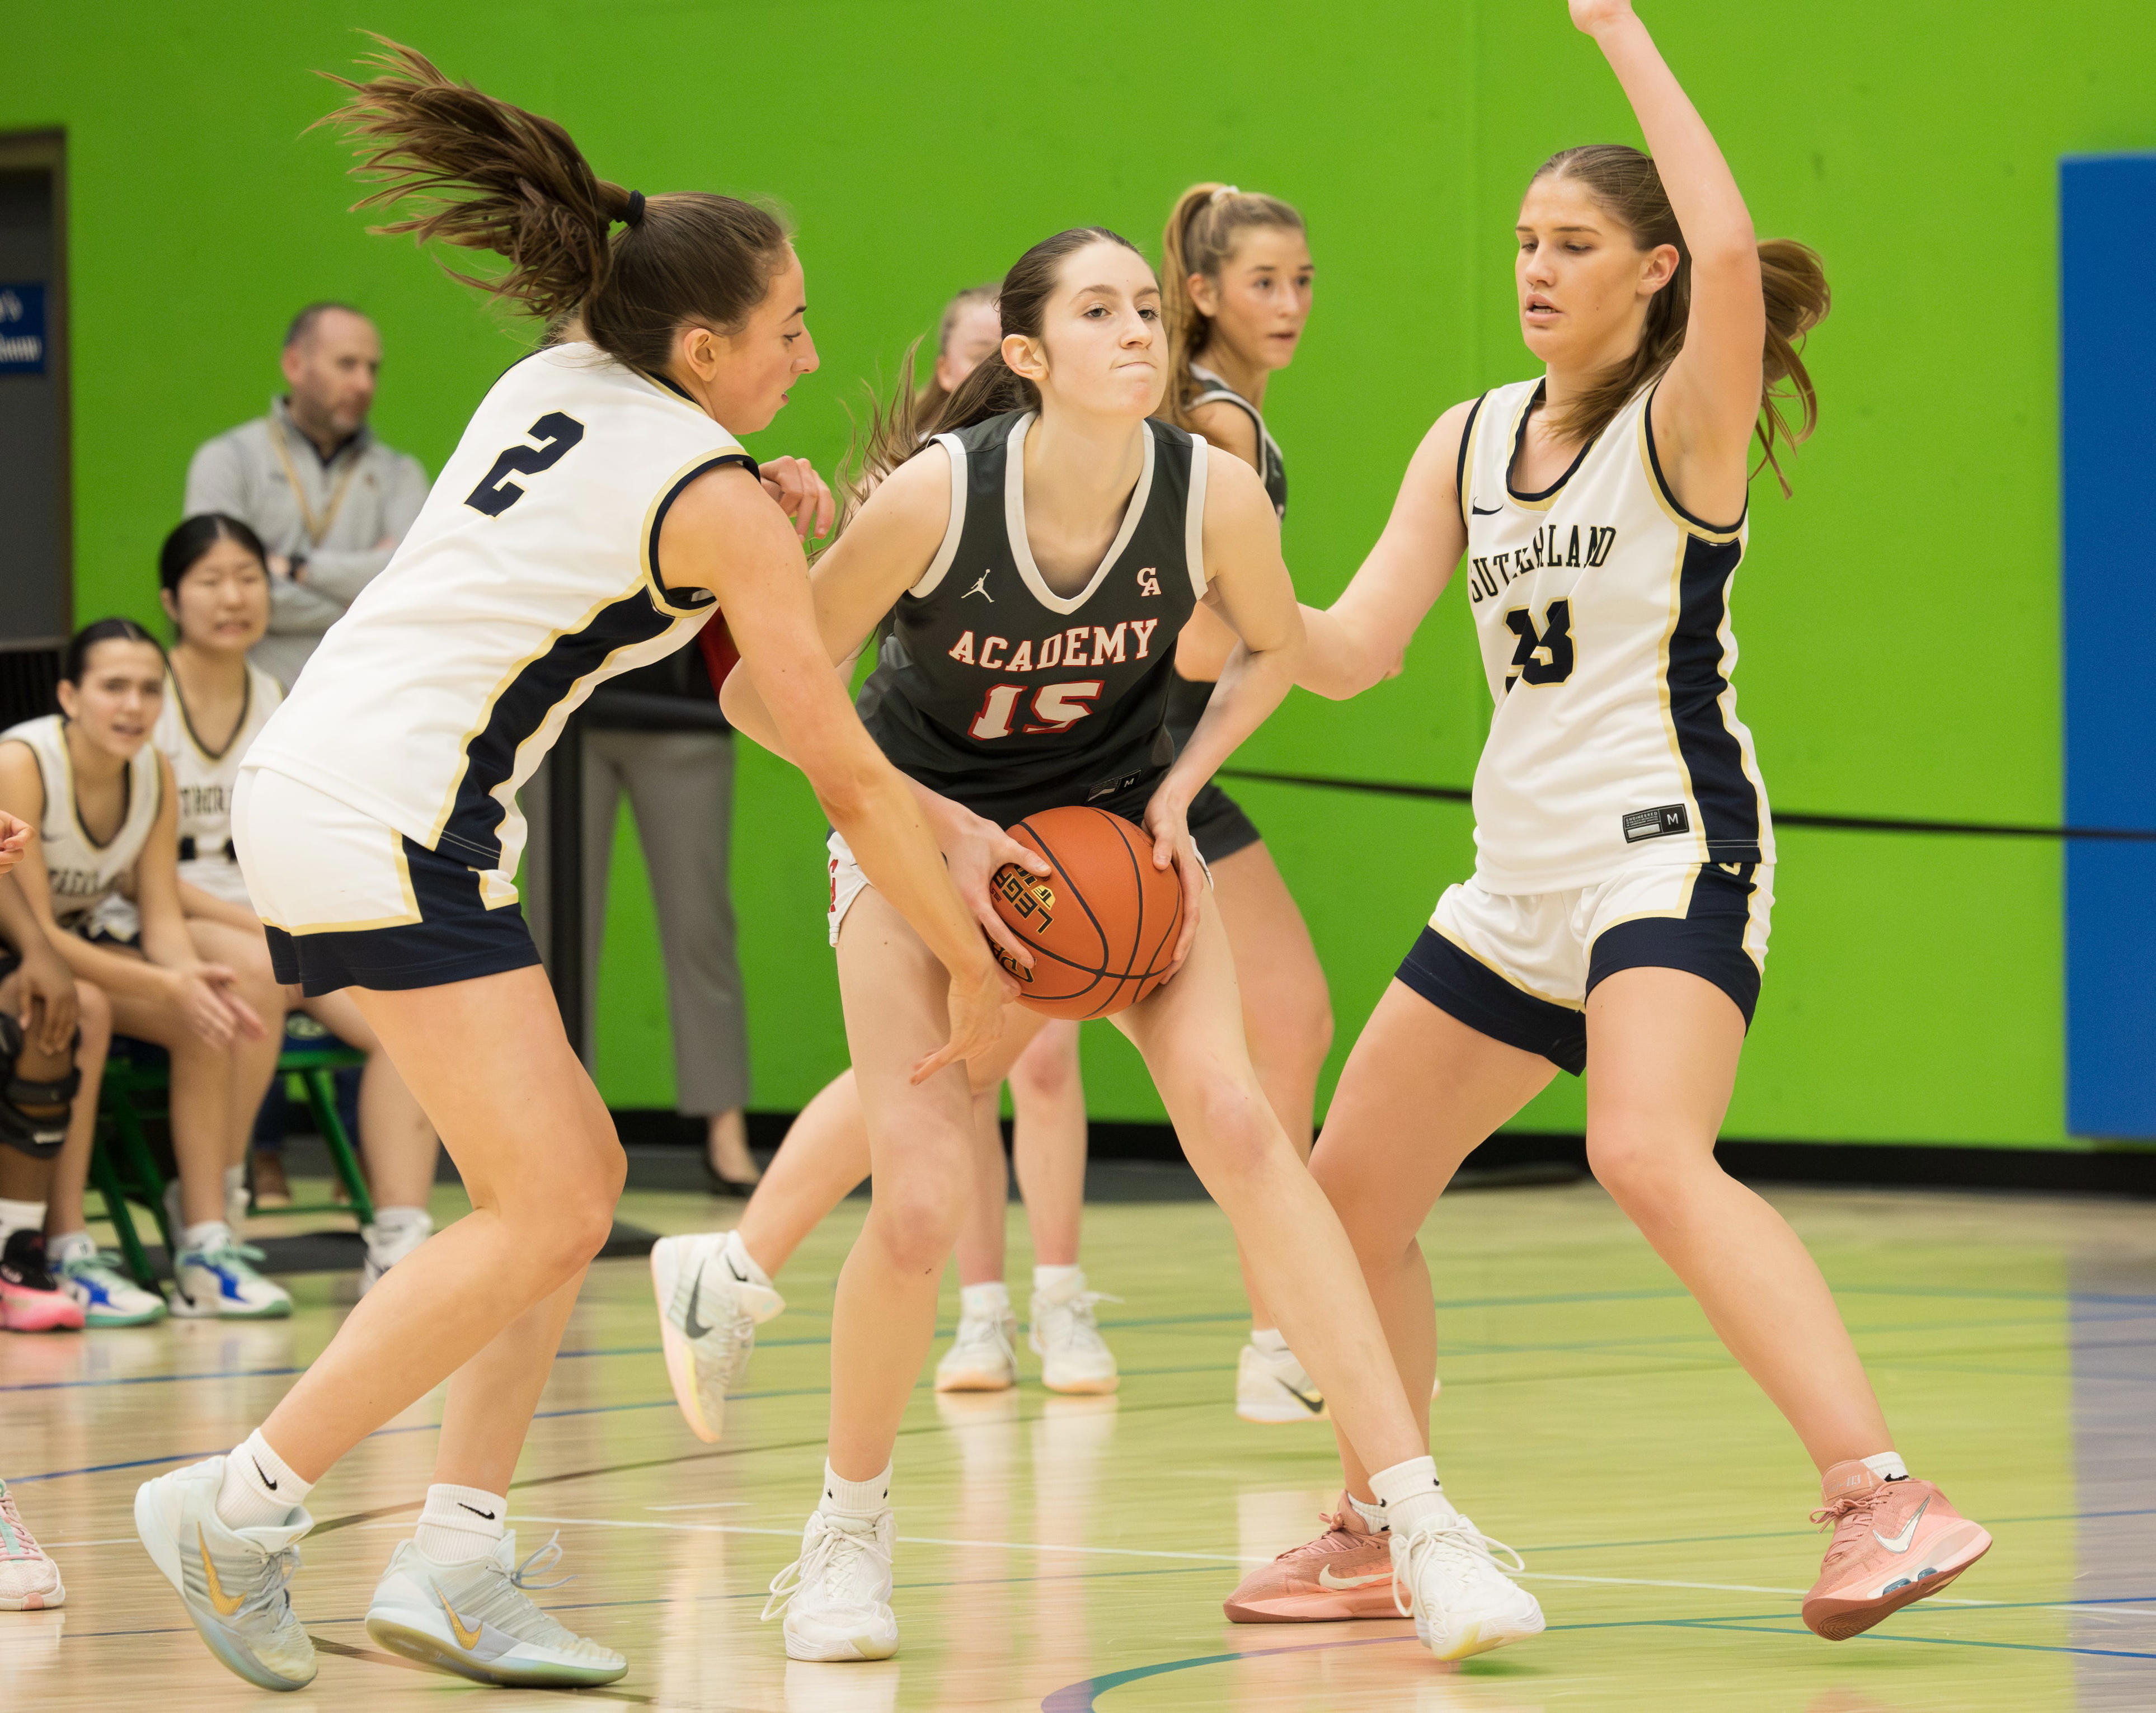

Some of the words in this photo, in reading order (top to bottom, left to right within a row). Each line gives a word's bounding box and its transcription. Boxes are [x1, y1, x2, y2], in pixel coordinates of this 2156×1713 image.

[462, 409, 586, 521] 2
[1136, 567, 1162, 597] CA
[948, 618, 1158, 672] ACADEMY
[967, 680, 1105, 741] 15
[1124, 778, 1135, 788] M
[1626, 811, 1658, 822] ENGINEERED
[1666, 813, 1679, 825] M
